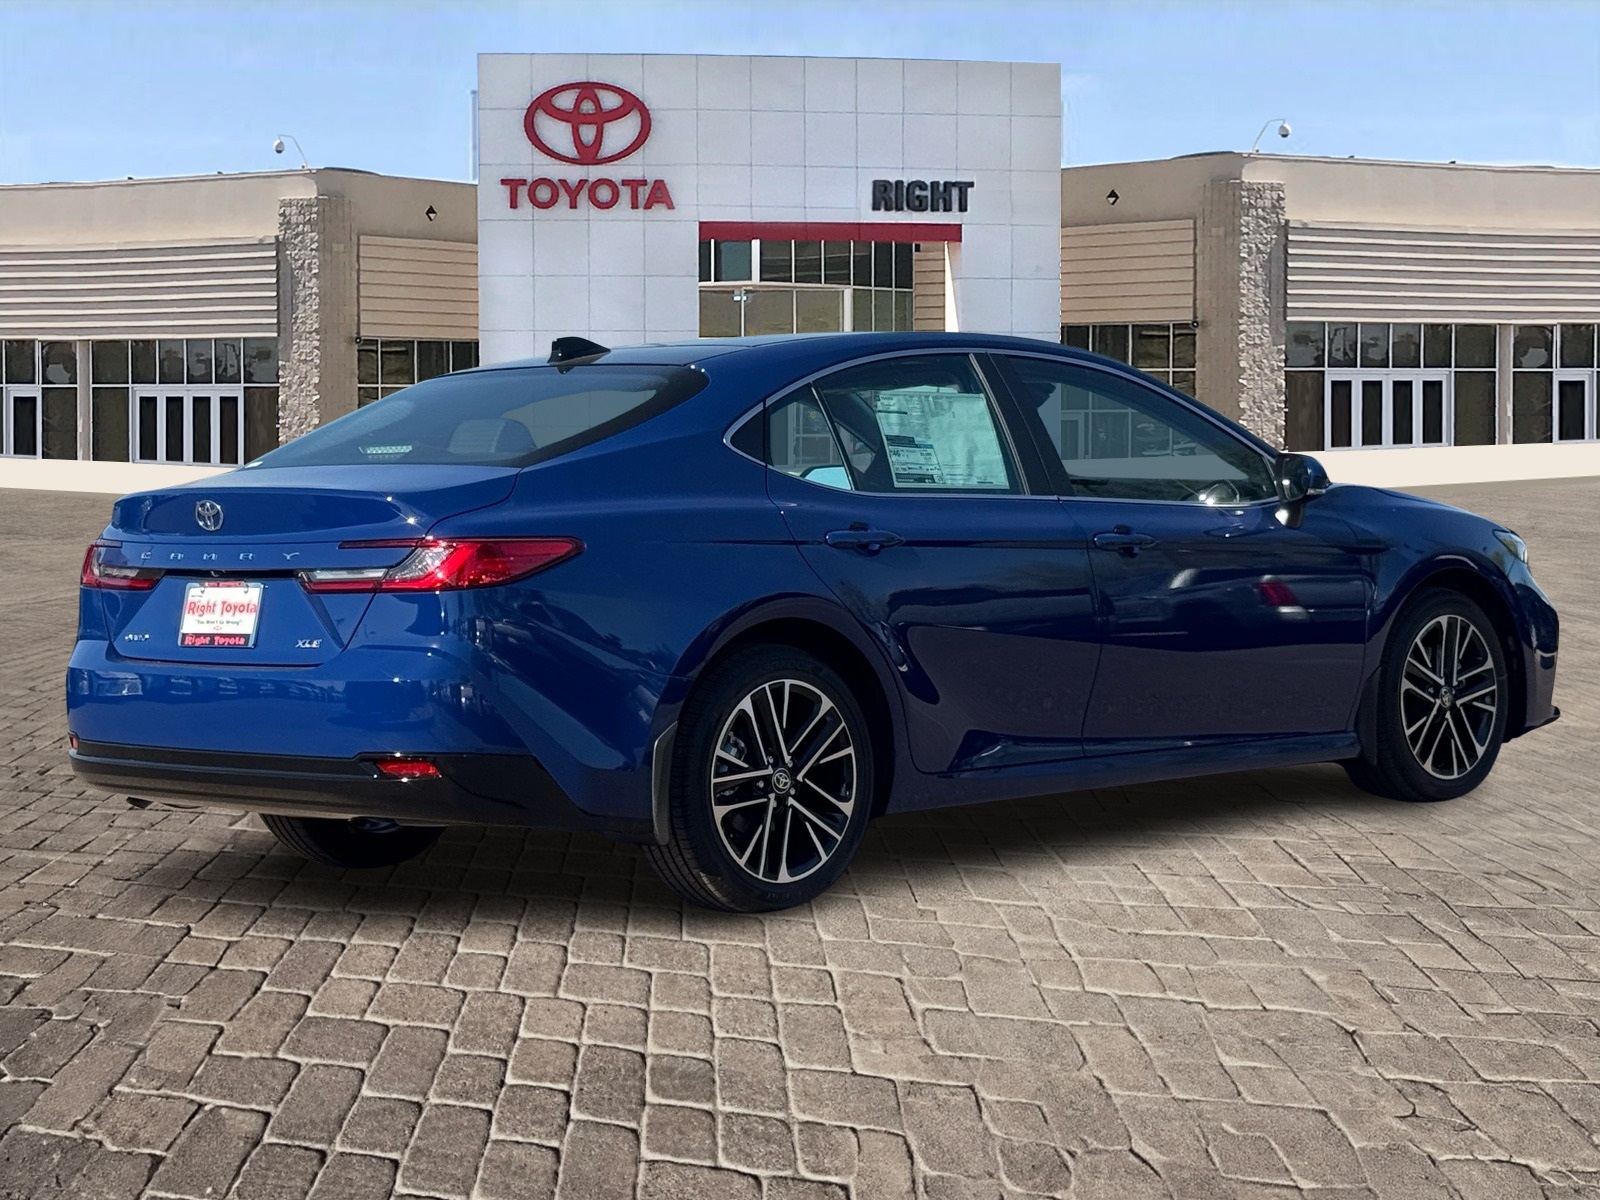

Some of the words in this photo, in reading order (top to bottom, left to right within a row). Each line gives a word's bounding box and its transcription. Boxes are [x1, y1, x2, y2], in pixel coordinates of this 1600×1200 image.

[501, 178, 675, 210] TOYOTA
[871, 180, 975, 213] RIGHT
[141, 551, 300, 561] CAMRY
[187, 600, 217, 617] Right
[221, 600, 257, 616] Toyota
[184, 635, 211, 646] Right
[214, 635, 246, 646] Toyota
[295, 638, 322, 649] XLE
